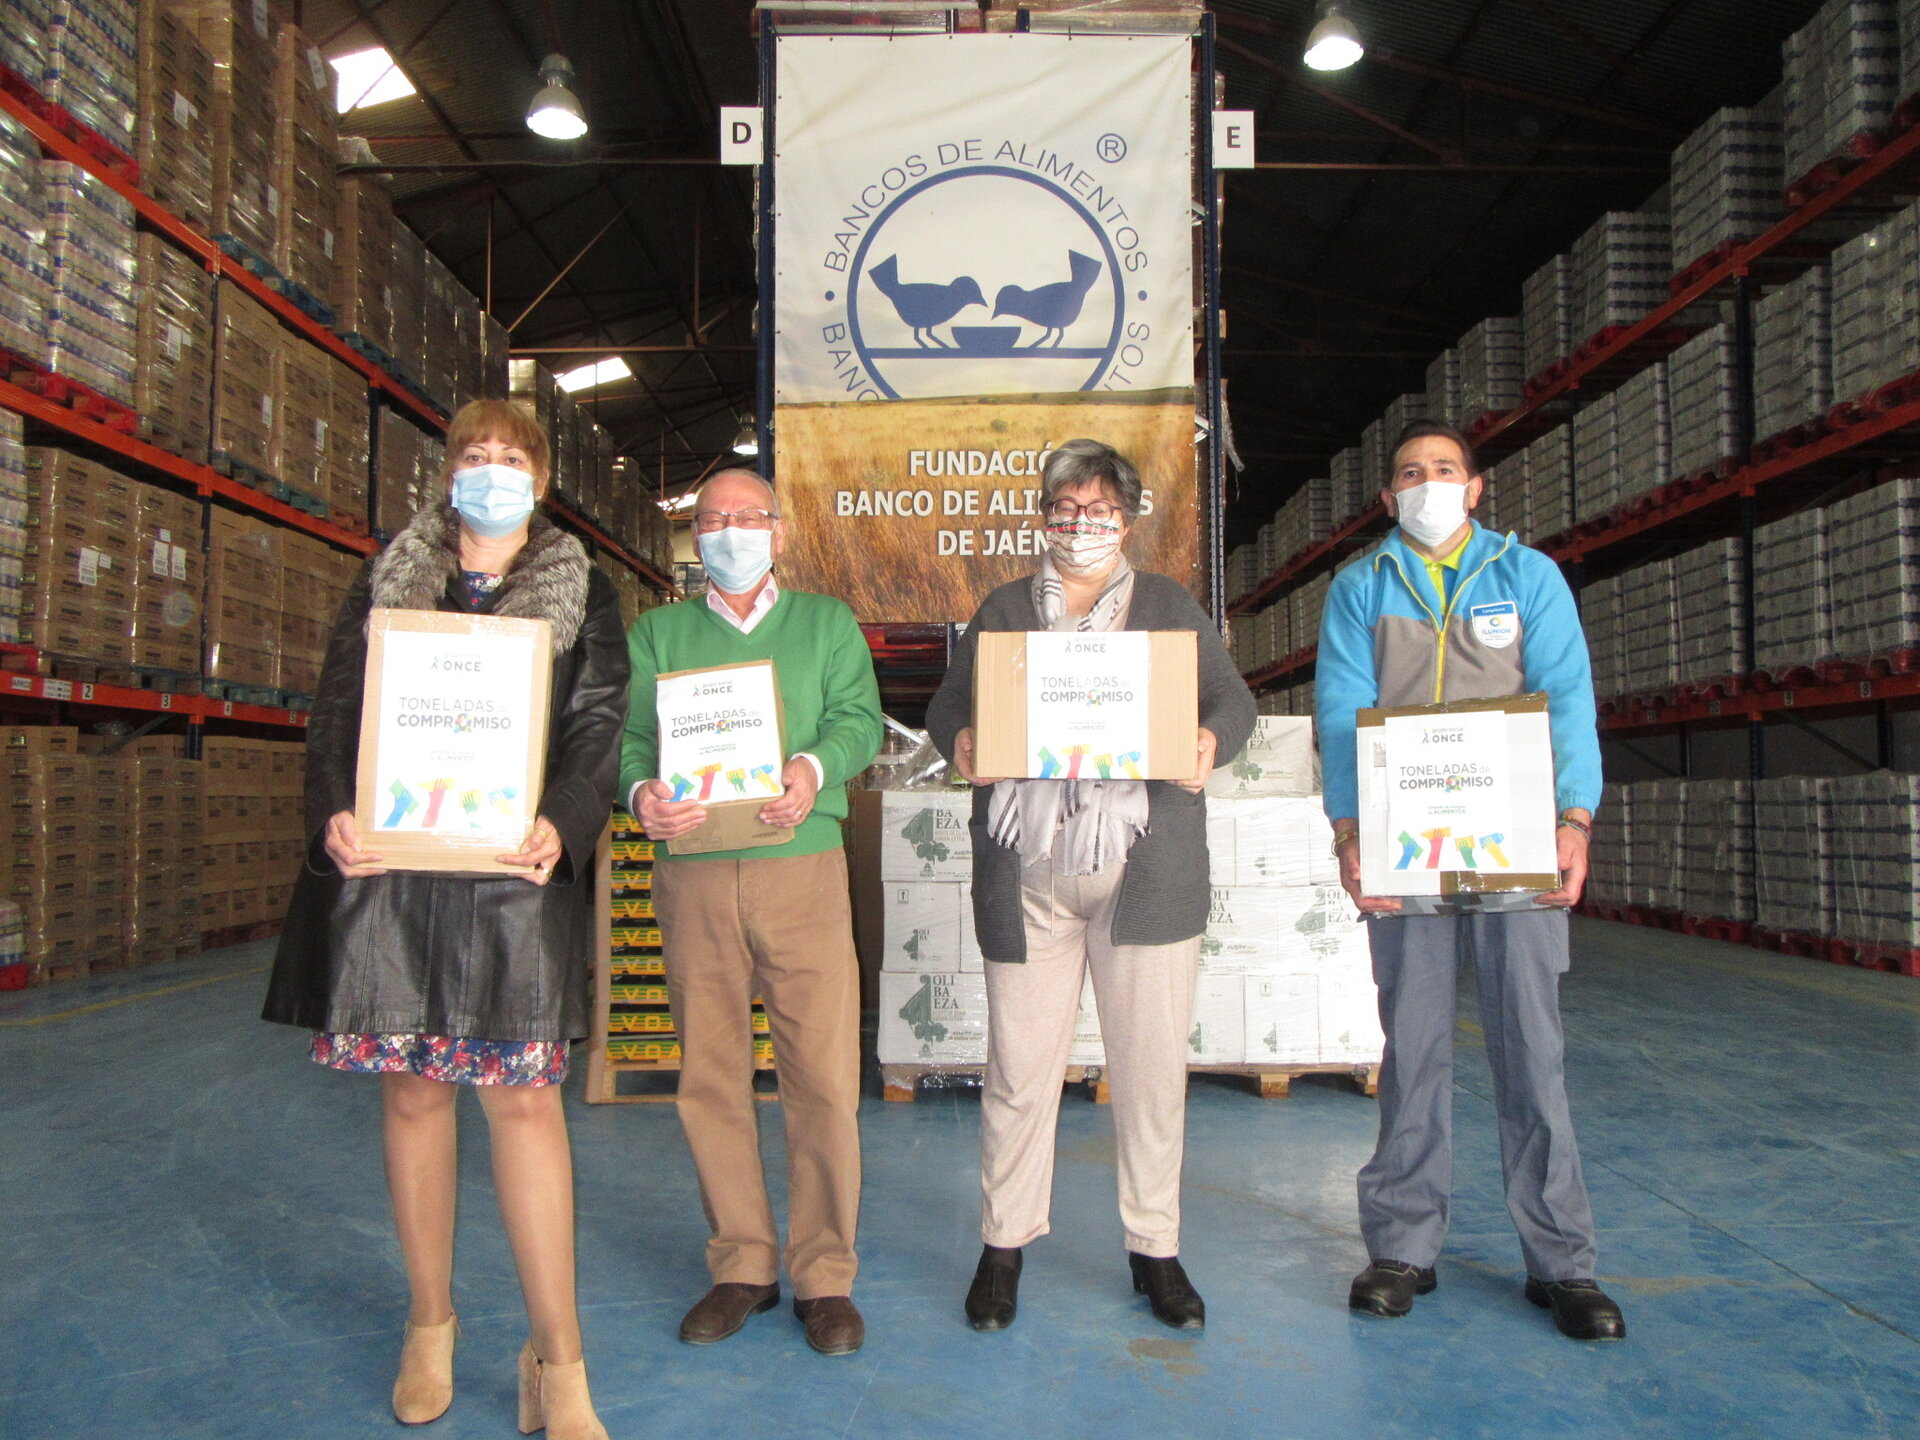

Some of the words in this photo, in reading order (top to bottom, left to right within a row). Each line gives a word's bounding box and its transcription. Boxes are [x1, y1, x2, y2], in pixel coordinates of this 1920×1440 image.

[731, 121, 752, 145] D
[1226, 125, 1242, 150] E
[823, 154, 928, 273] BANCOS
[937, 138, 985, 167] DE
[995, 139, 1149, 273] ALIMENTOS
[910, 441, 1053, 477] FUNDACIÓ
[836, 489, 934, 517] BANCO
[943, 489, 980, 517] DE
[938, 530, 974, 557] DE
[1075, 643, 1106, 653] ONCE
[443, 660, 481, 672] ONCE
[1041, 676, 1118, 688] TONELADAS
[84, 684, 91, 698] 2
[702, 686, 733, 696] ONCE
[1862, 683, 1869, 697] 8
[163, 695, 170, 707] 3
[1041, 690, 1133, 705] COMPROMISO
[399, 697, 494, 712] TONELADAS
[397, 713, 512, 731] COMPROMISO
[671, 708, 747, 727] TONELADAS
[671, 718, 762, 738] COMPROMISO
[1432, 733, 1464, 743] ONCE
[1400, 763, 1477, 776] TONELADAS
[1399, 776, 1493, 791] COMPROMISO
[936, 809, 953, 818] BA
[936, 818, 961, 829] EZA
[1210, 901, 1225, 911] BA
[1209, 913, 1233, 923] EZA
[1328, 913, 1351, 922] EZA
[932, 975, 955, 985] OLI
[934, 986, 951, 997] BA
[934, 998, 959, 1009] EZA
